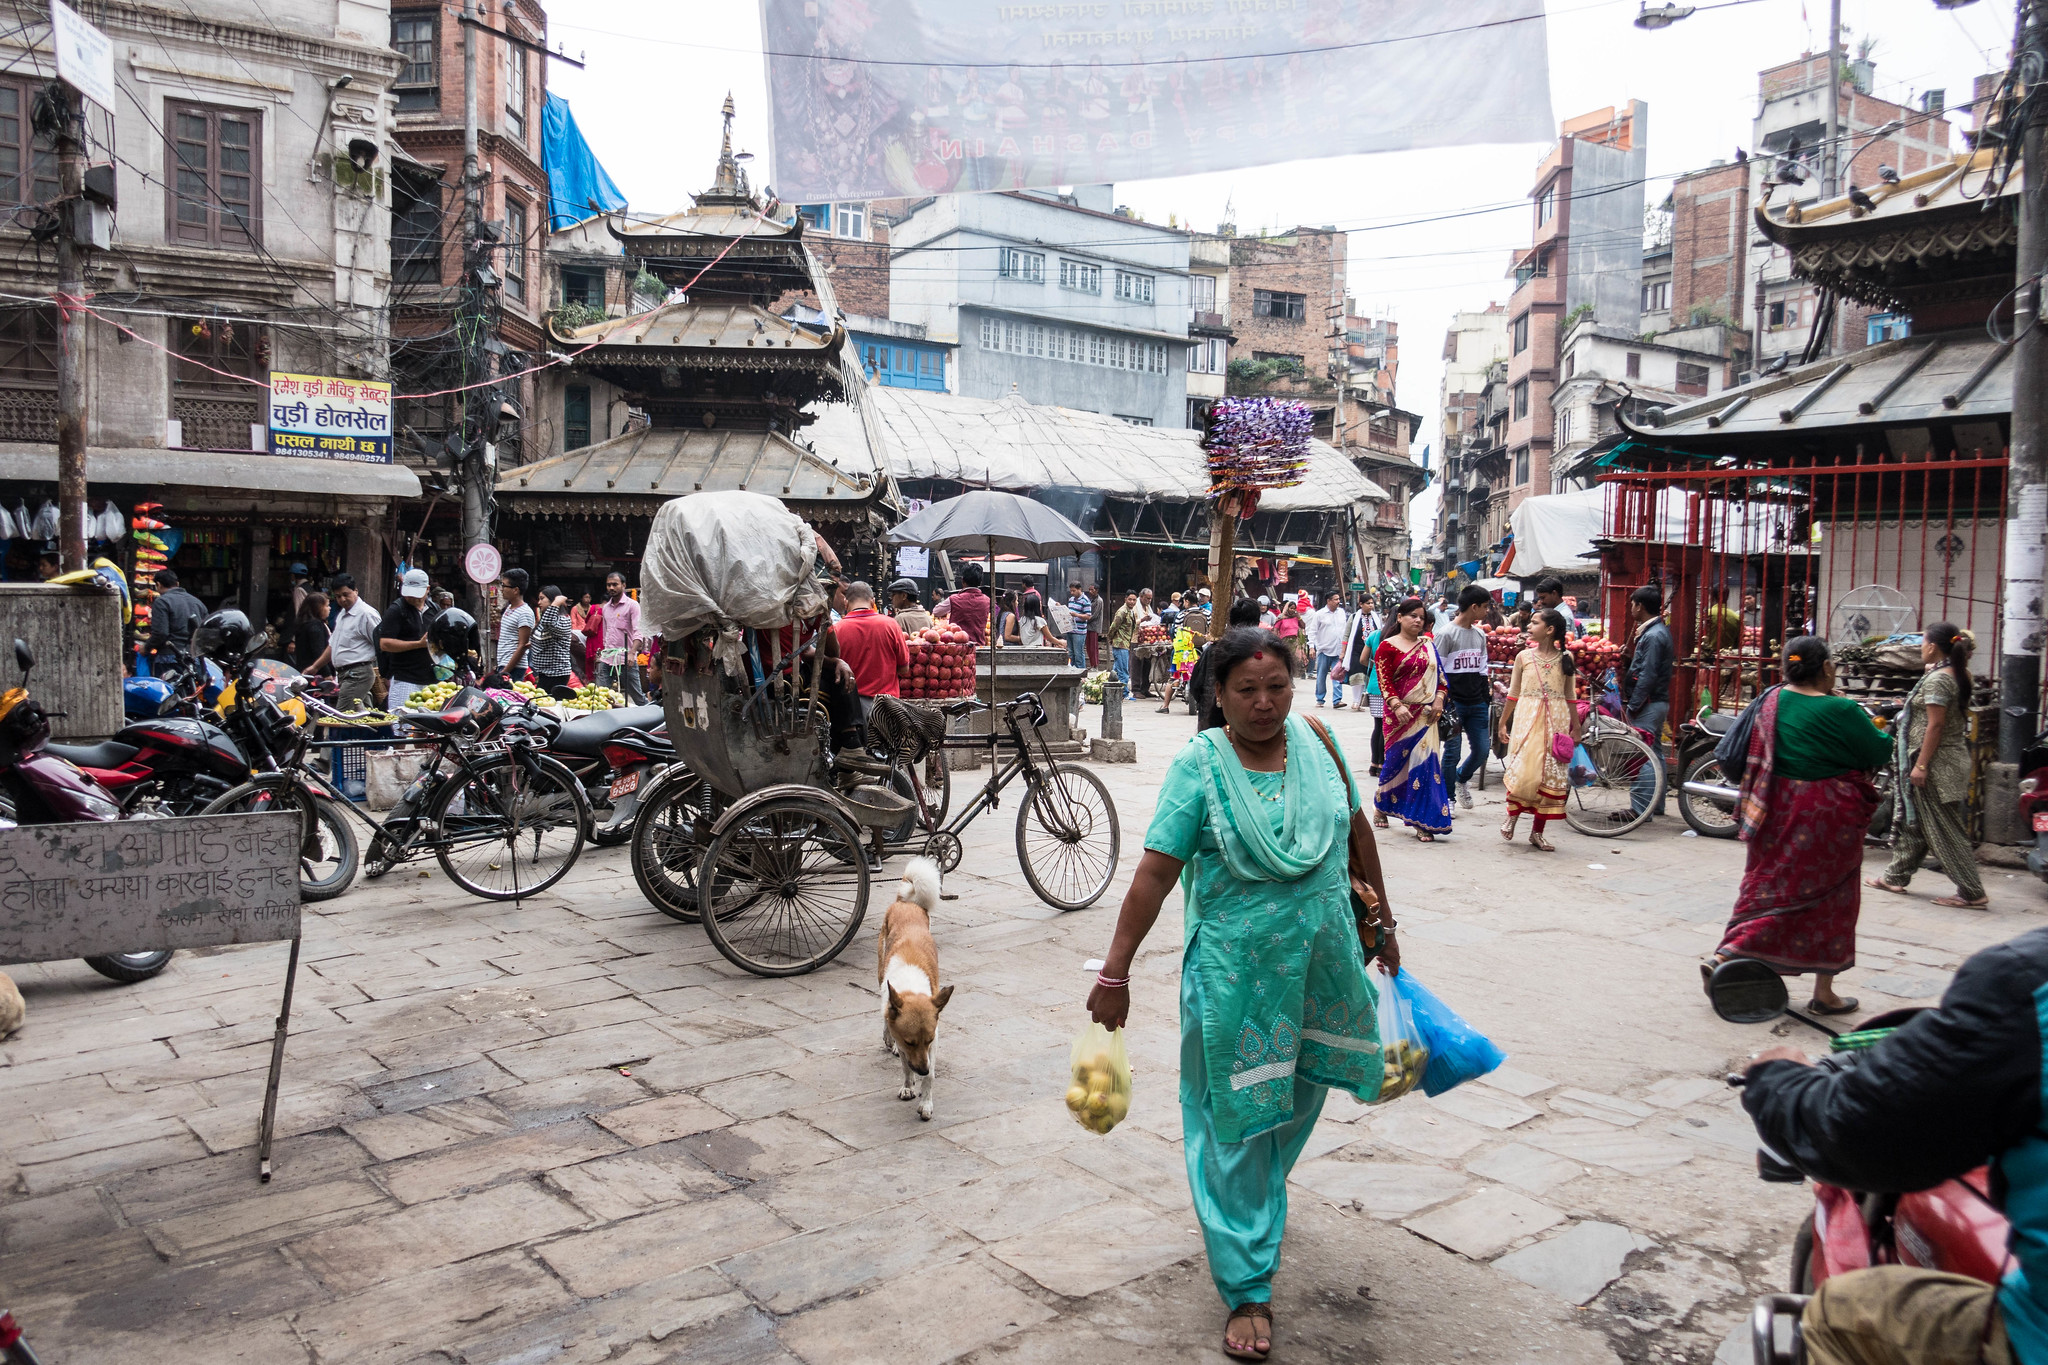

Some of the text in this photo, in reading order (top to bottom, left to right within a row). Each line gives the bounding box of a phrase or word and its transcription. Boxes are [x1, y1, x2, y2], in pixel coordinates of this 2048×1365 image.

[274, 376, 300, 396] रमेश
[315, 403, 388, 431] होलसेल
[275, 434, 316, 448] पसल
[320, 436, 356, 452] माथी
[361, 441, 376, 453] छ
